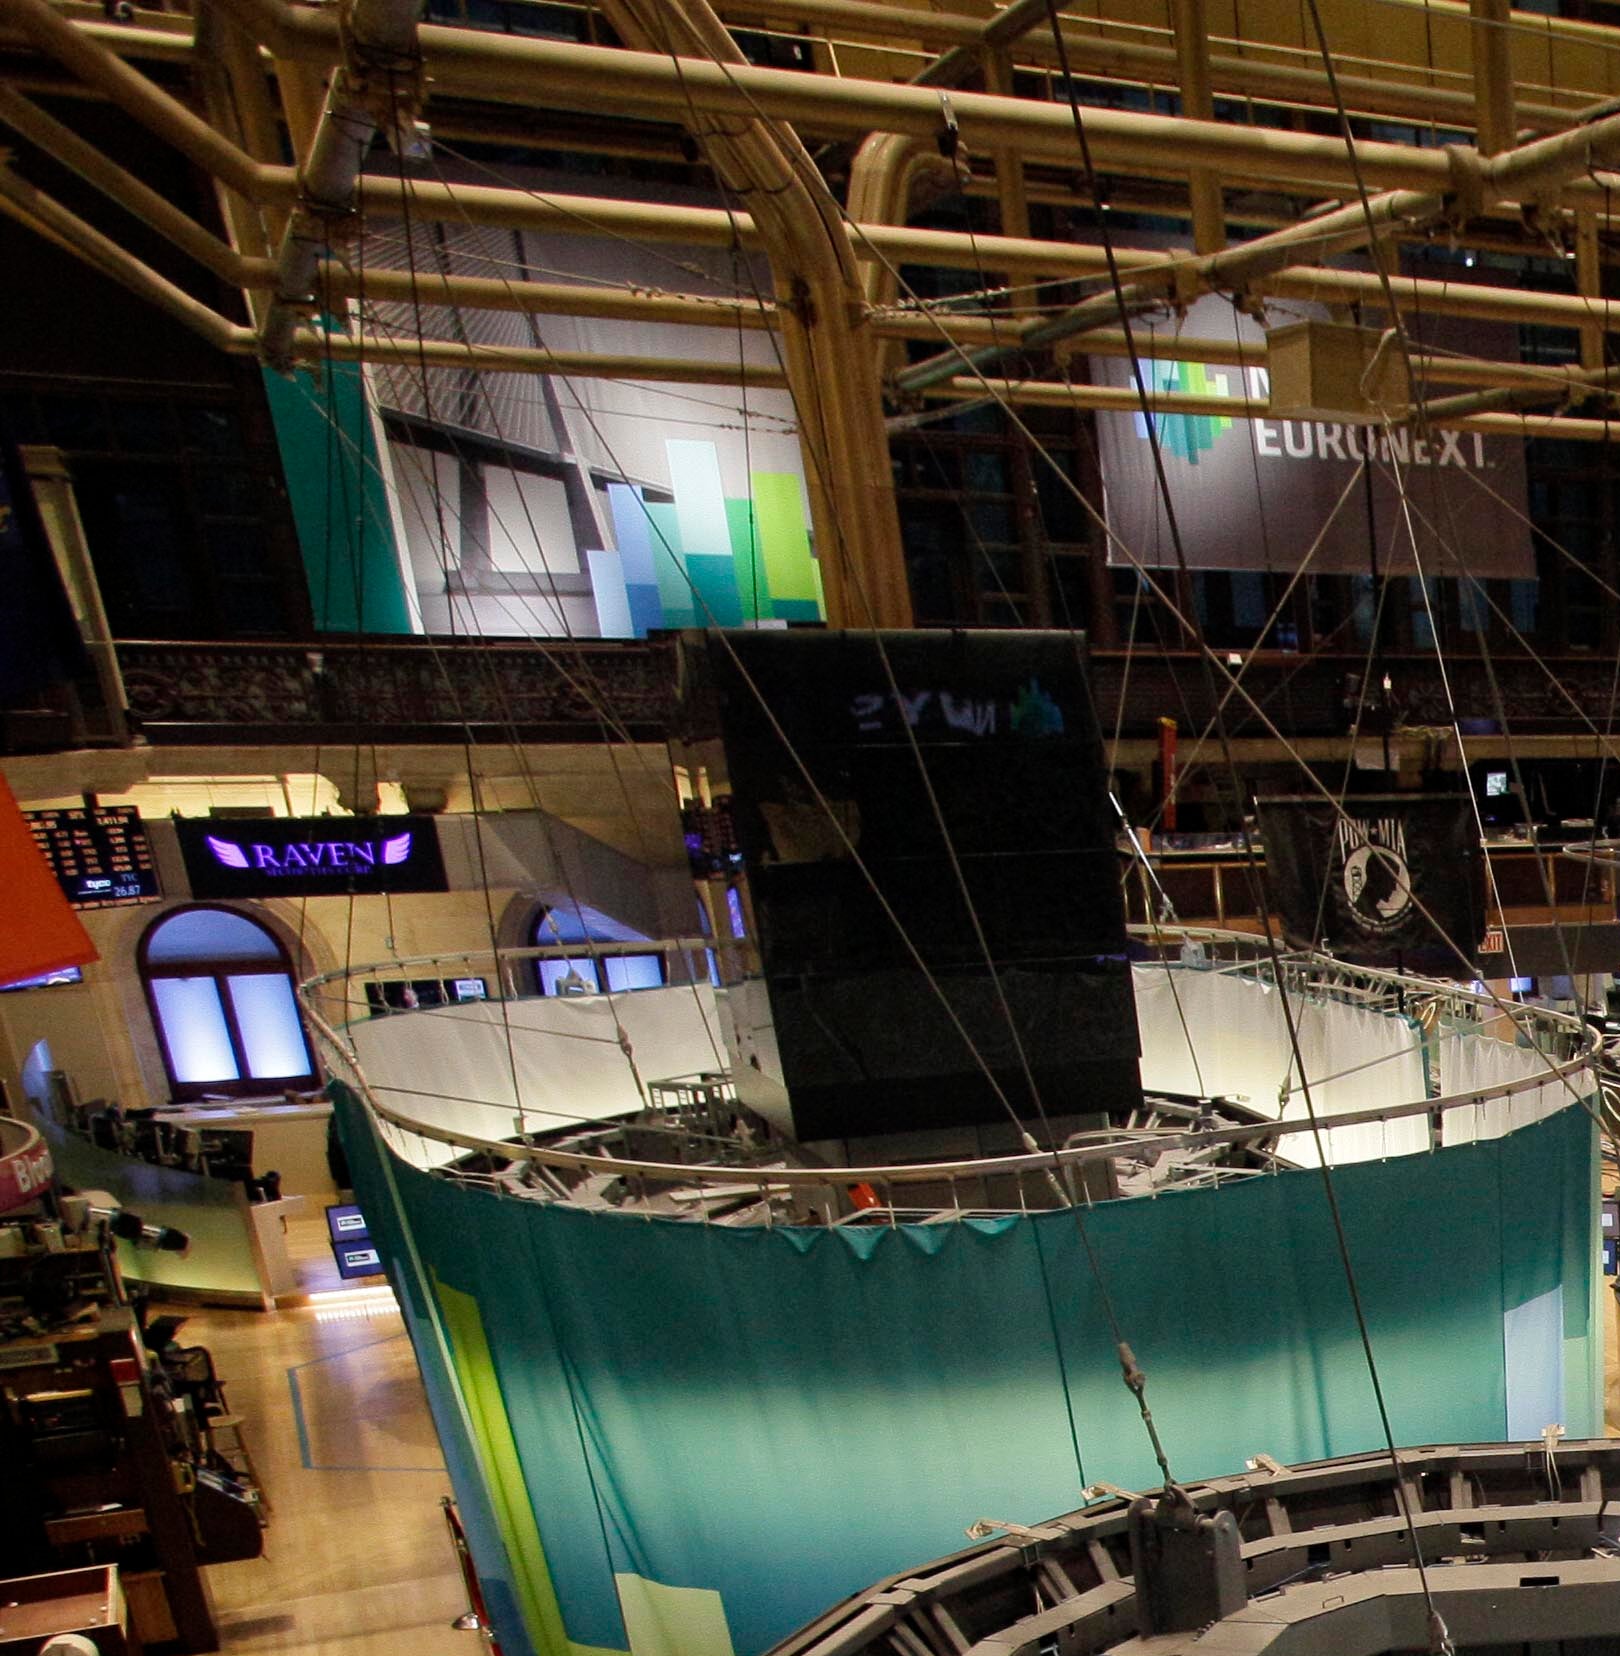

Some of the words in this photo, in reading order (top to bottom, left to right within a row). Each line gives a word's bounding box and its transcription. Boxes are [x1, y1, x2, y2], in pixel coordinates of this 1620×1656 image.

[1339, 818, 1370, 864] POW
[1378, 818, 1408, 865] MIA
[251, 842, 376, 868] RAVEN
[114, 885, 141, 897] 26.87
